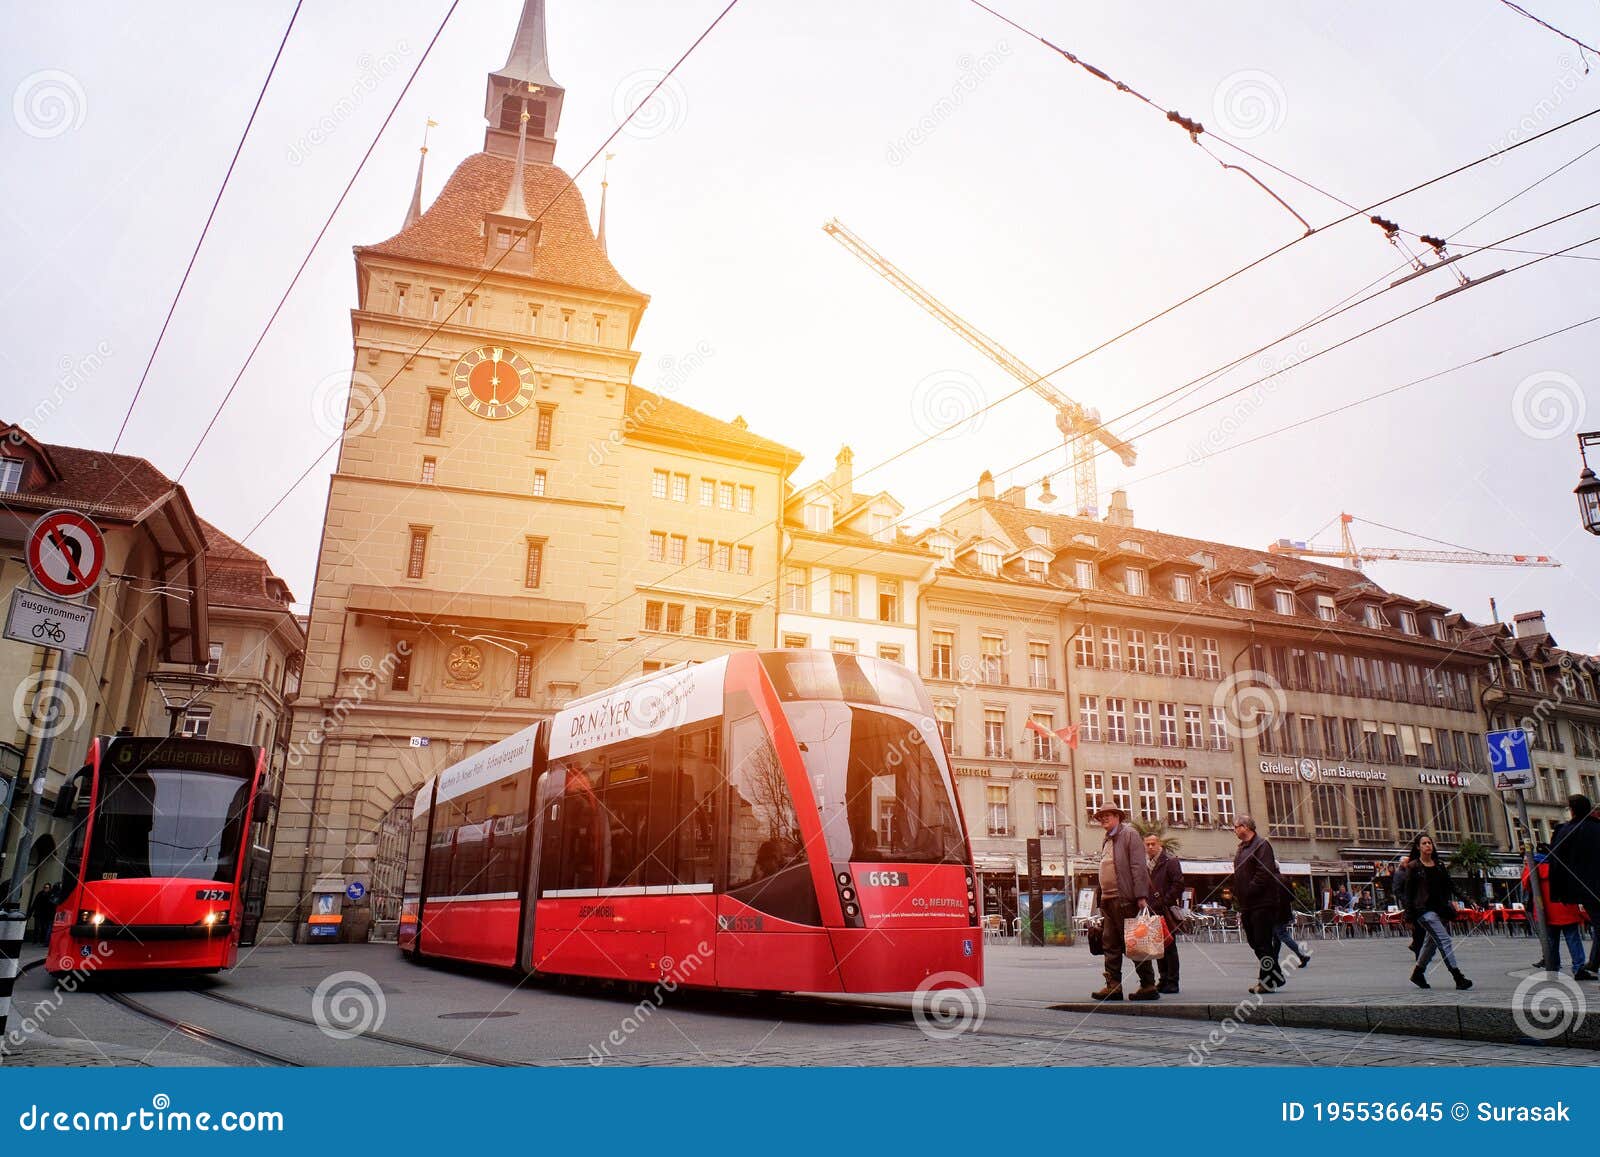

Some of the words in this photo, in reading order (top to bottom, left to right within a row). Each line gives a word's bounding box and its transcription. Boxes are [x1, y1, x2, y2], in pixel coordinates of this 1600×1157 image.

[21, 600, 86, 623] ausgenommen
[1260, 761, 1294, 775] Gfeller
[1322, 769, 1337, 778] am
[1339, 766, 1387, 781] Bärenplatz
[1419, 770, 1471, 788] PLATTFORM
[869, 871, 900, 887] 663
[203, 889, 225, 901] 752
[929, 897, 965, 908] NEUTRAL
